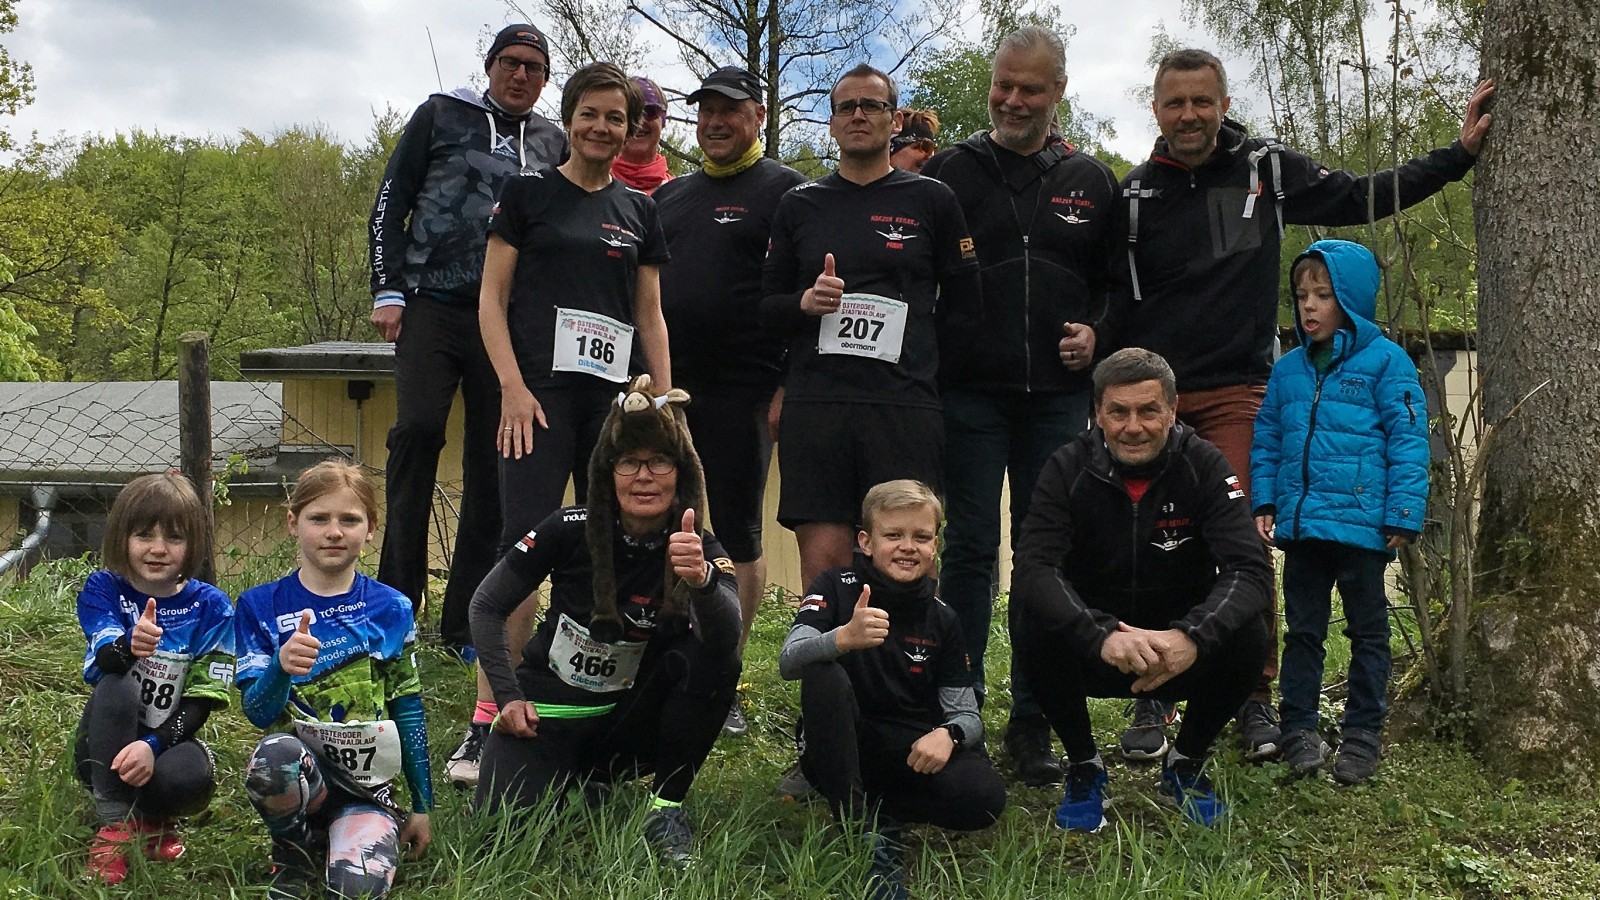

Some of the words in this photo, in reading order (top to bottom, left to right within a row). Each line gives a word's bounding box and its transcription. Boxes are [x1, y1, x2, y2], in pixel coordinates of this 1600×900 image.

[373, 179, 393, 242] ATHLETIX
[842, 302, 876, 312] OSTERODER
[841, 308, 886, 319] STADTWALDLAUF
[577, 320, 609, 332] OSTERODER
[838, 317, 885, 342] 207
[577, 327, 617, 342] STADTWALDLAUF
[576, 335, 615, 365] 186
[841, 341, 876, 352] obermann
[347, 644, 362, 655] am
[569, 651, 618, 678] 466
[320, 728, 362, 739] OSTERODER
[320, 735, 377, 746] STADTWALDLAUF
[323, 743, 377, 772] 887
